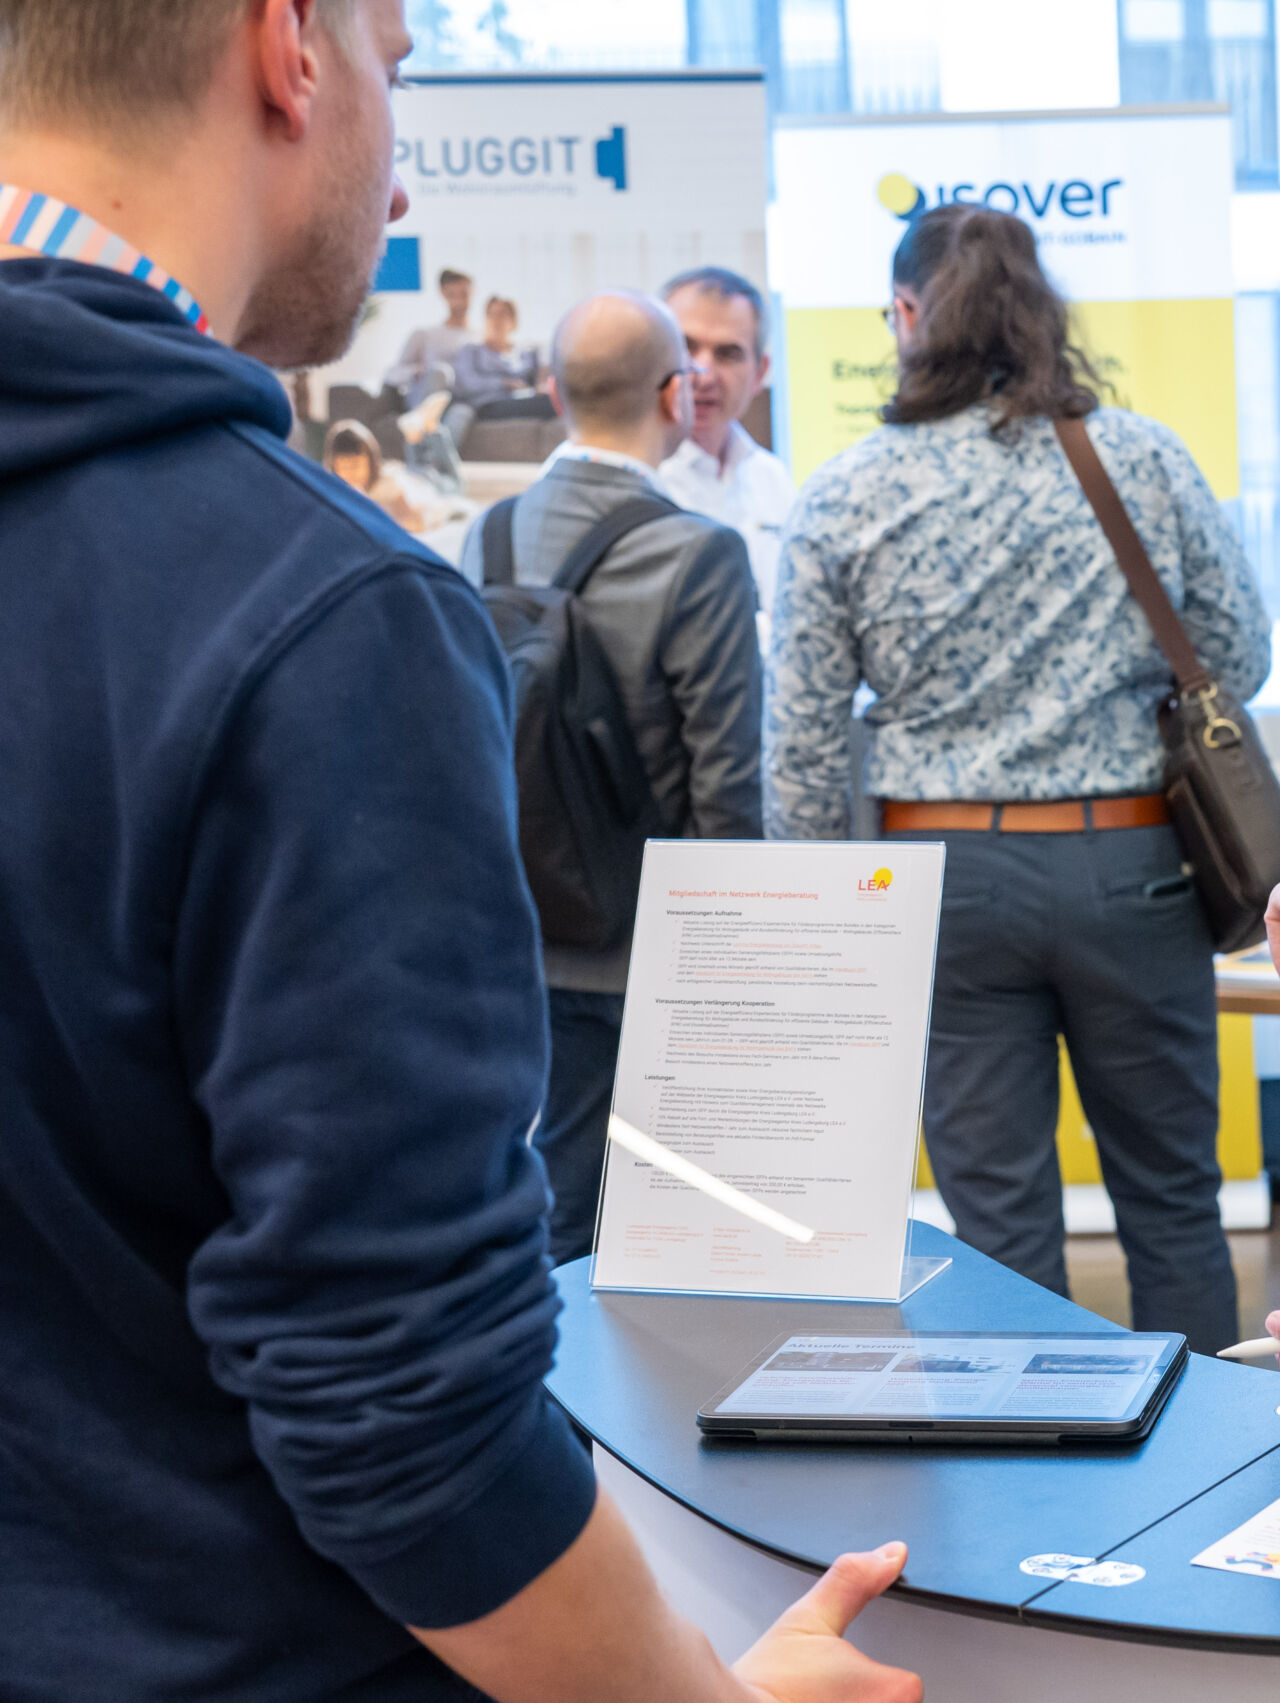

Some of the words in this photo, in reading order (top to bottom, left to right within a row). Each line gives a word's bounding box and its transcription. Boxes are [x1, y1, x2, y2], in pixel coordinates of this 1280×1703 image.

[394, 136, 580, 177] PLUGGIT
[857, 879, 890, 891] LEA
[669, 890, 717, 898] Mitgliedschaft
[763, 891, 819, 901] Energieberatung
